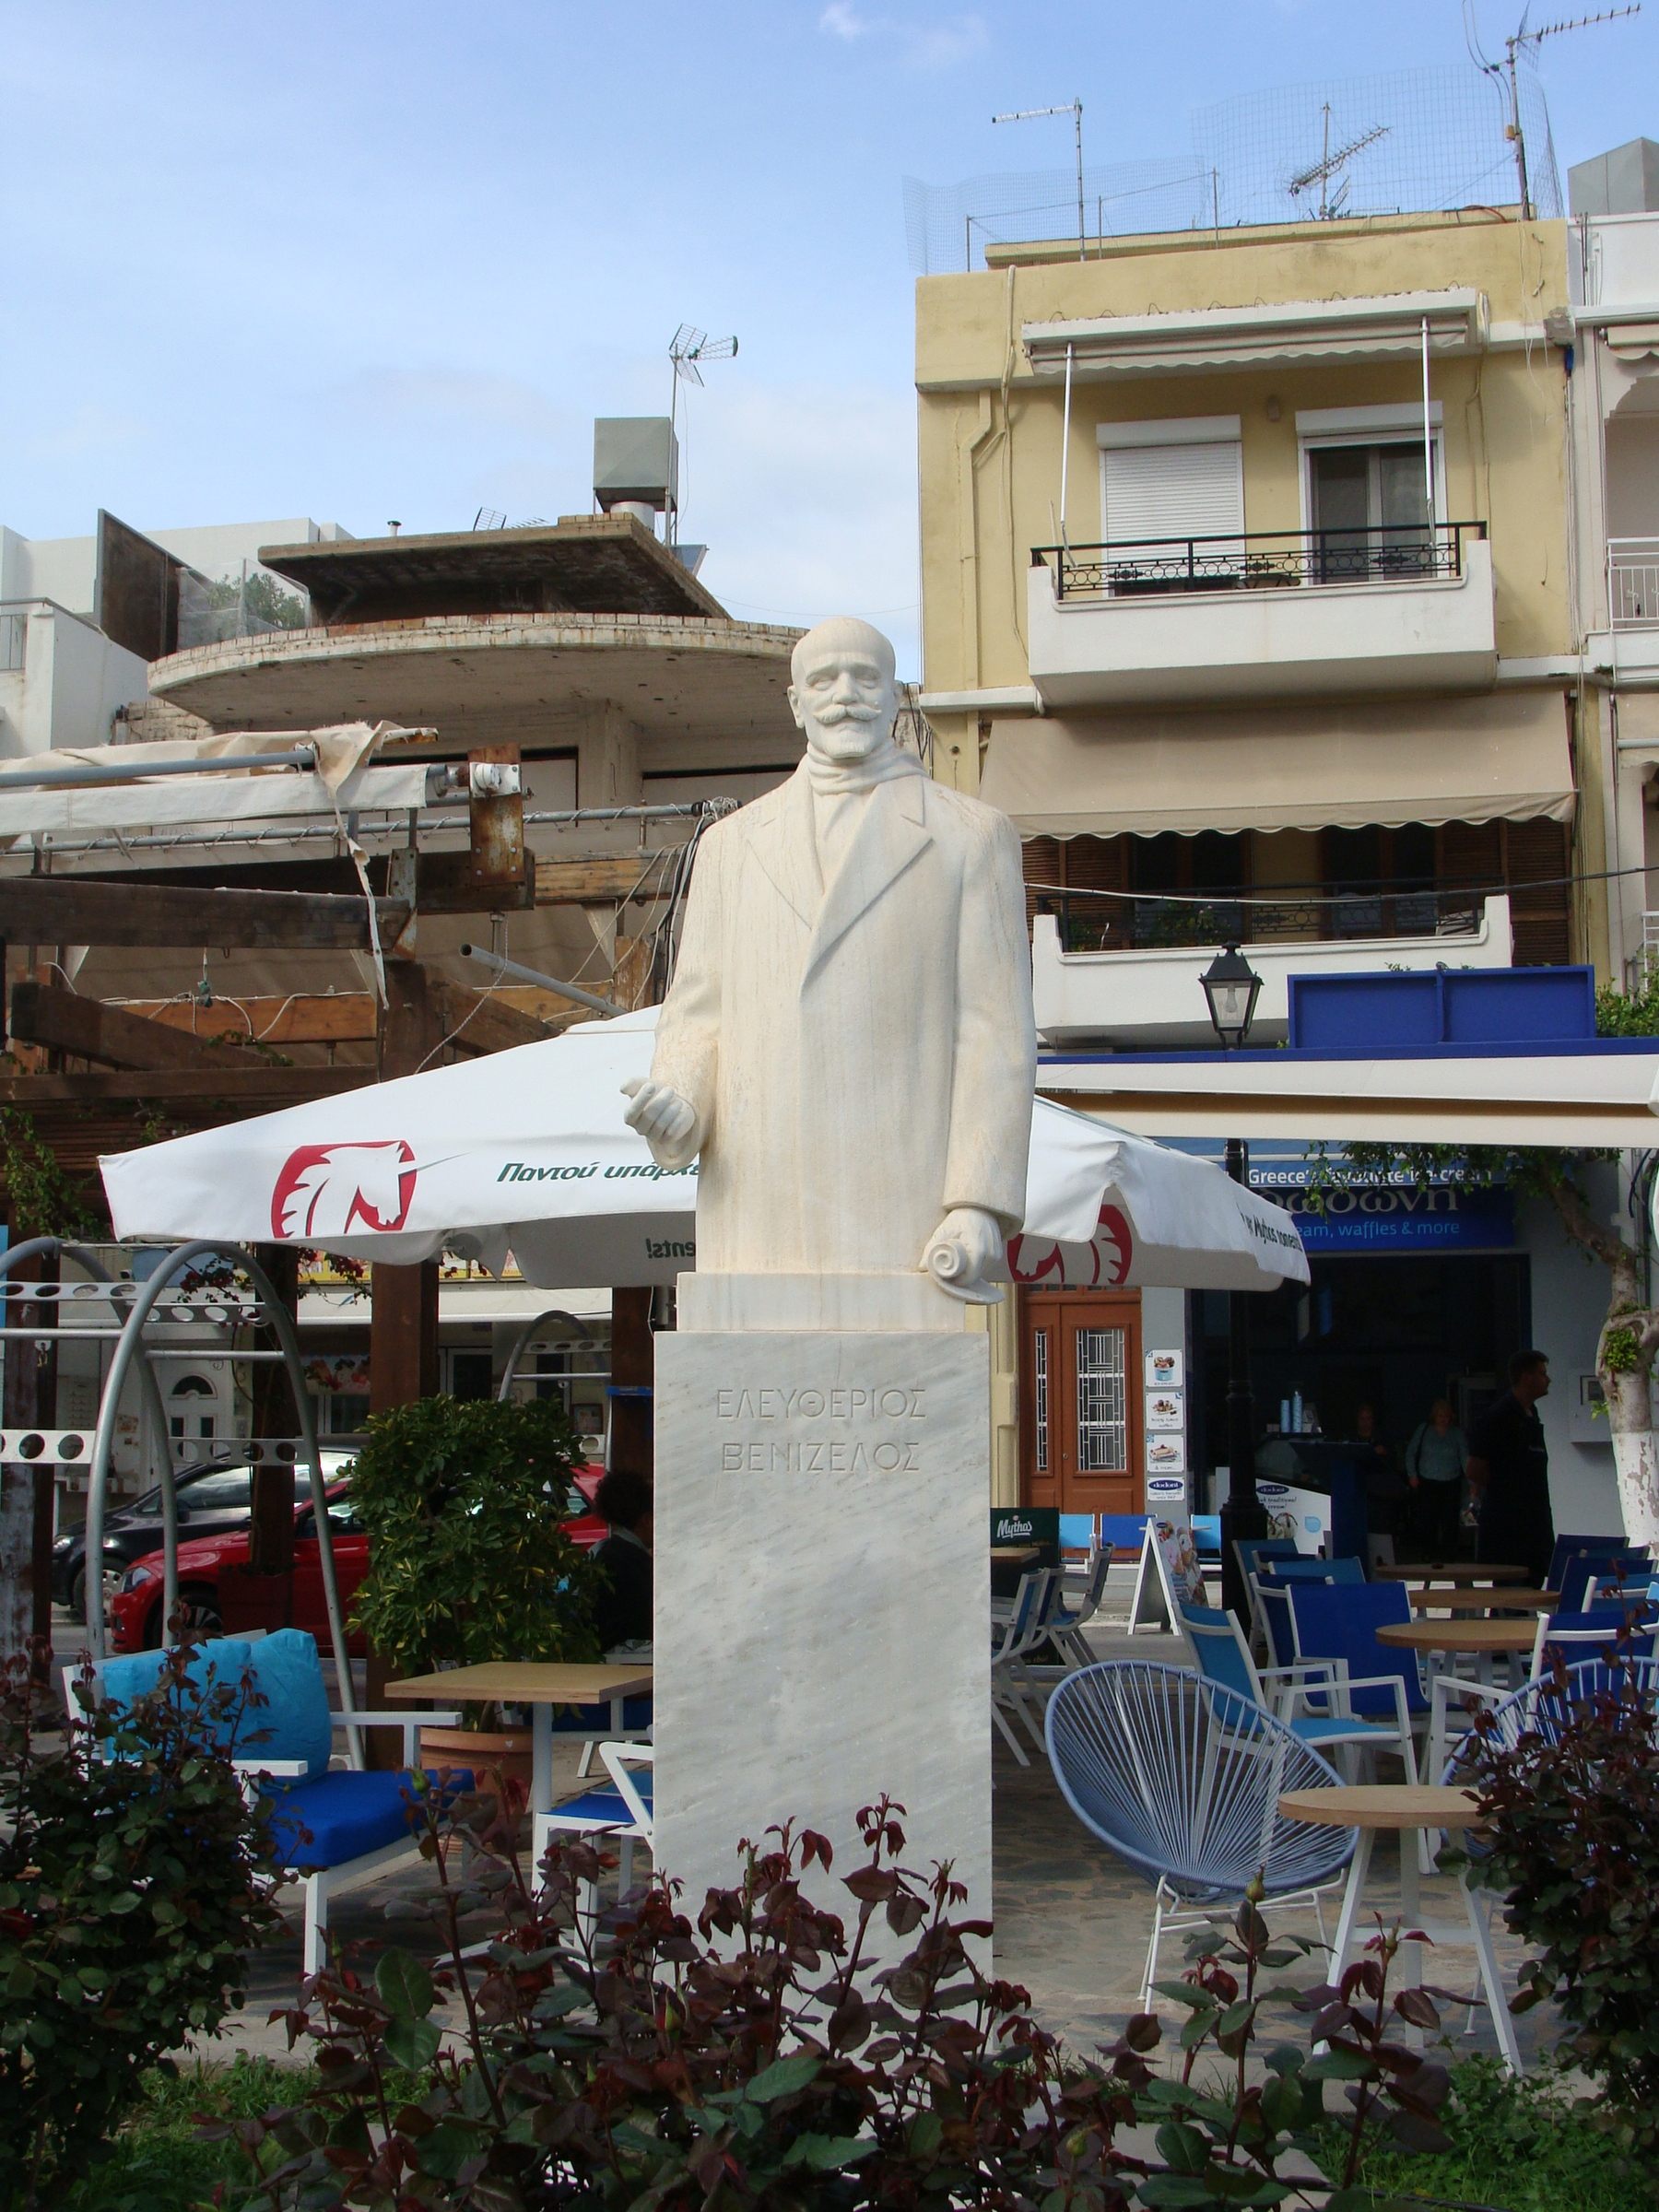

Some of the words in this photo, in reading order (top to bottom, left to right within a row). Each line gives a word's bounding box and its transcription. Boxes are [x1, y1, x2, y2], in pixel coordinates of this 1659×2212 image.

[497, 1161, 601, 1182] Παντού
[604, 1160, 699, 1182] υπάρχε
[1298, 1224, 1334, 1239] eam,
[1338, 1221, 1397, 1239] waffles
[1402, 1221, 1413, 1234] &
[1417, 1221, 1460, 1235] more
[716, 1388, 927, 1420] ΕΛΕΥΘΕΡΙΟΣ
[722, 1441, 921, 1473] ΒΕΝΙΖΕΛΟΣ
[996, 1518, 1033, 1539] Mythos
